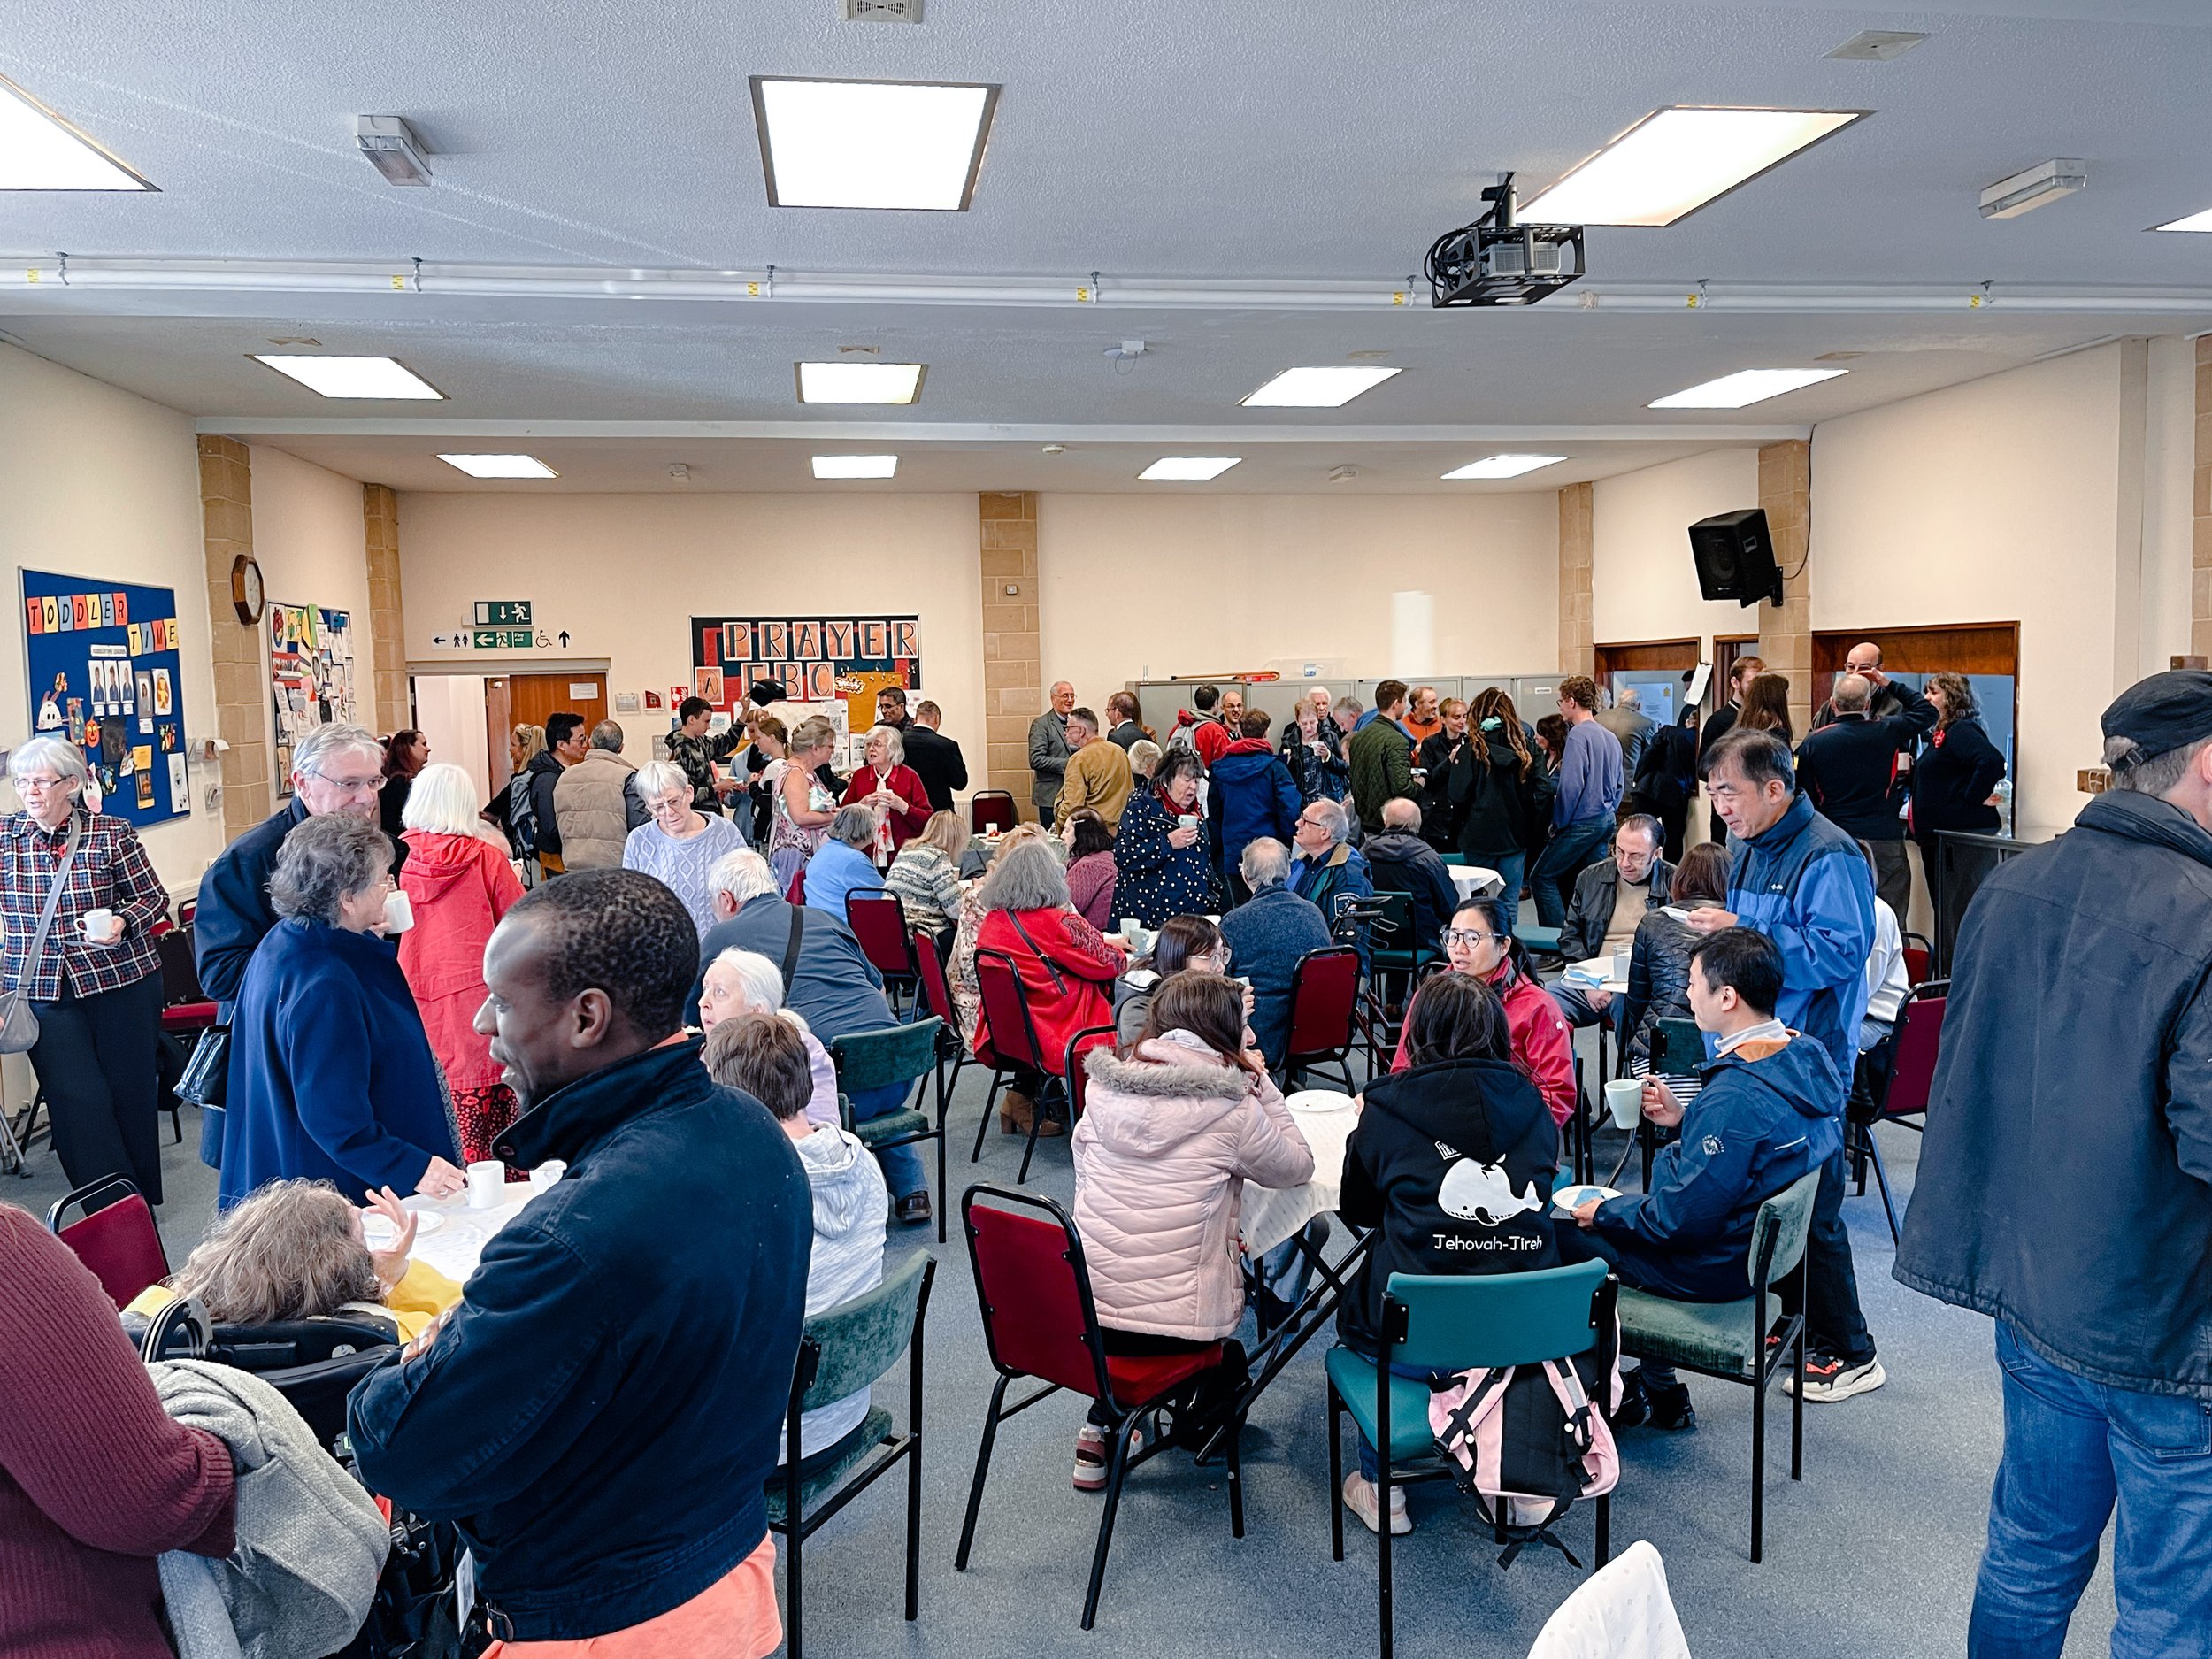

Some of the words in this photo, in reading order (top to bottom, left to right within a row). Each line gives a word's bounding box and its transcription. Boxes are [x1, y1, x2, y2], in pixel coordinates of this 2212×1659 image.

[30, 600, 125, 627] TODDLER
[130, 625, 175, 649] TIME
[728, 622, 916, 657] PRAYER
[1432, 1233, 1543, 1251] Jehovah-Jireh
